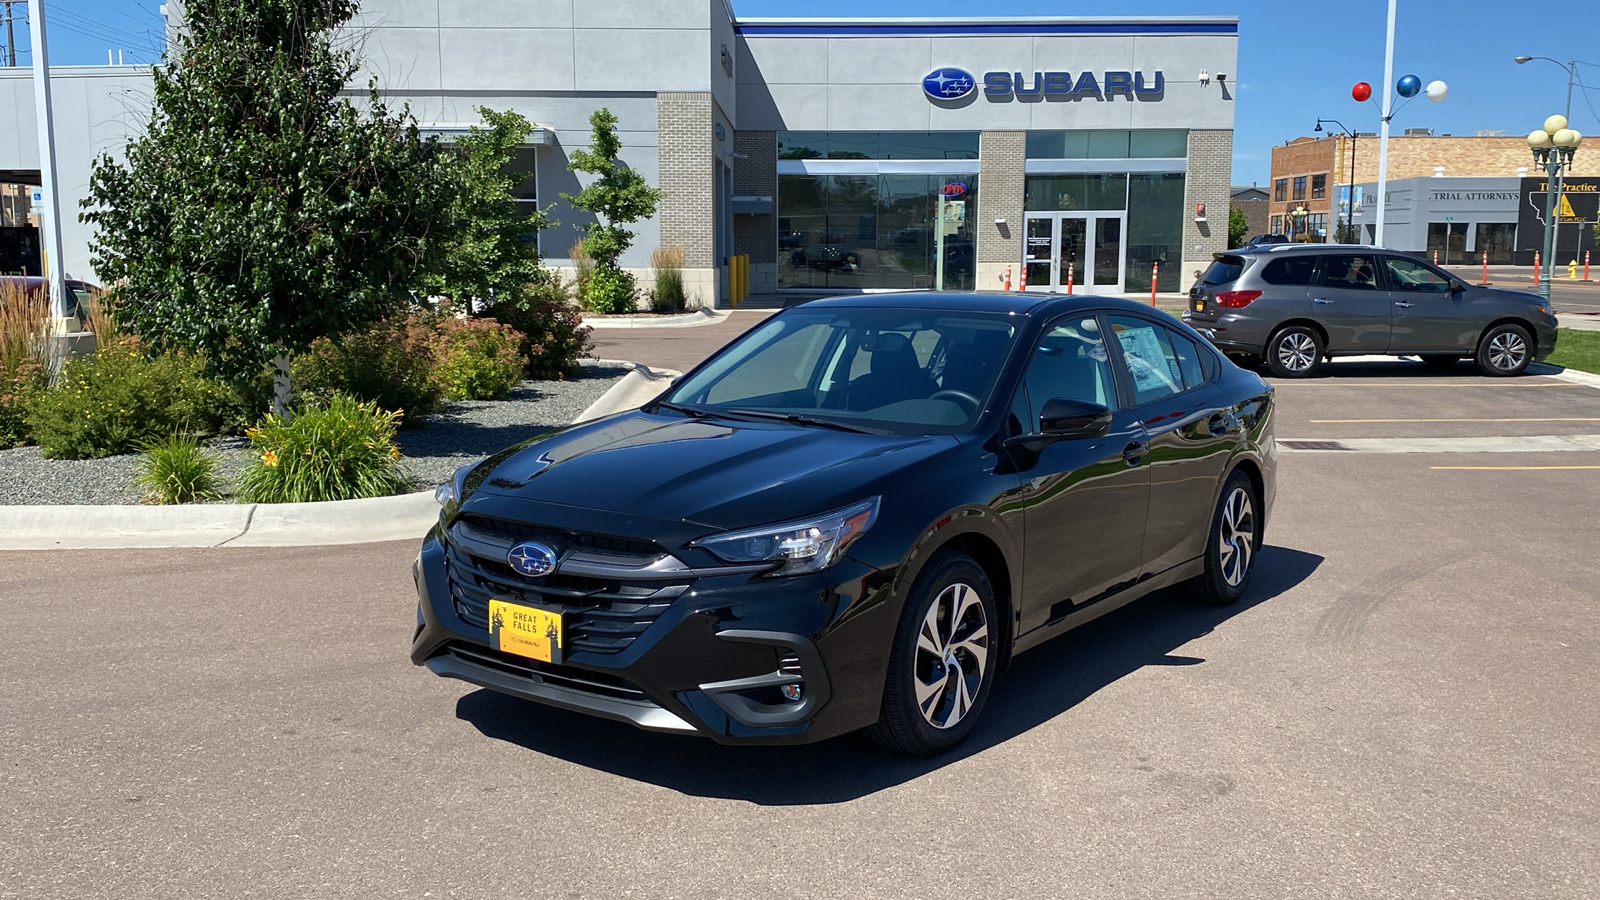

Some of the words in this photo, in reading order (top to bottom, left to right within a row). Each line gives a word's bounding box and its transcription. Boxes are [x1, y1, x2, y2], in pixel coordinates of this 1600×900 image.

[984, 71, 1163, 95] SUBARU
[942, 184, 965, 194] OPEN
[1563, 183, 1597, 191] Practice
[1433, 192, 1462, 200] TRIAL
[1464, 192, 1520, 200] ATTORNEYS
[513, 612, 537, 624] GREAT
[513, 621, 537, 633] FALLS
[518, 639, 540, 647] SUBARU
